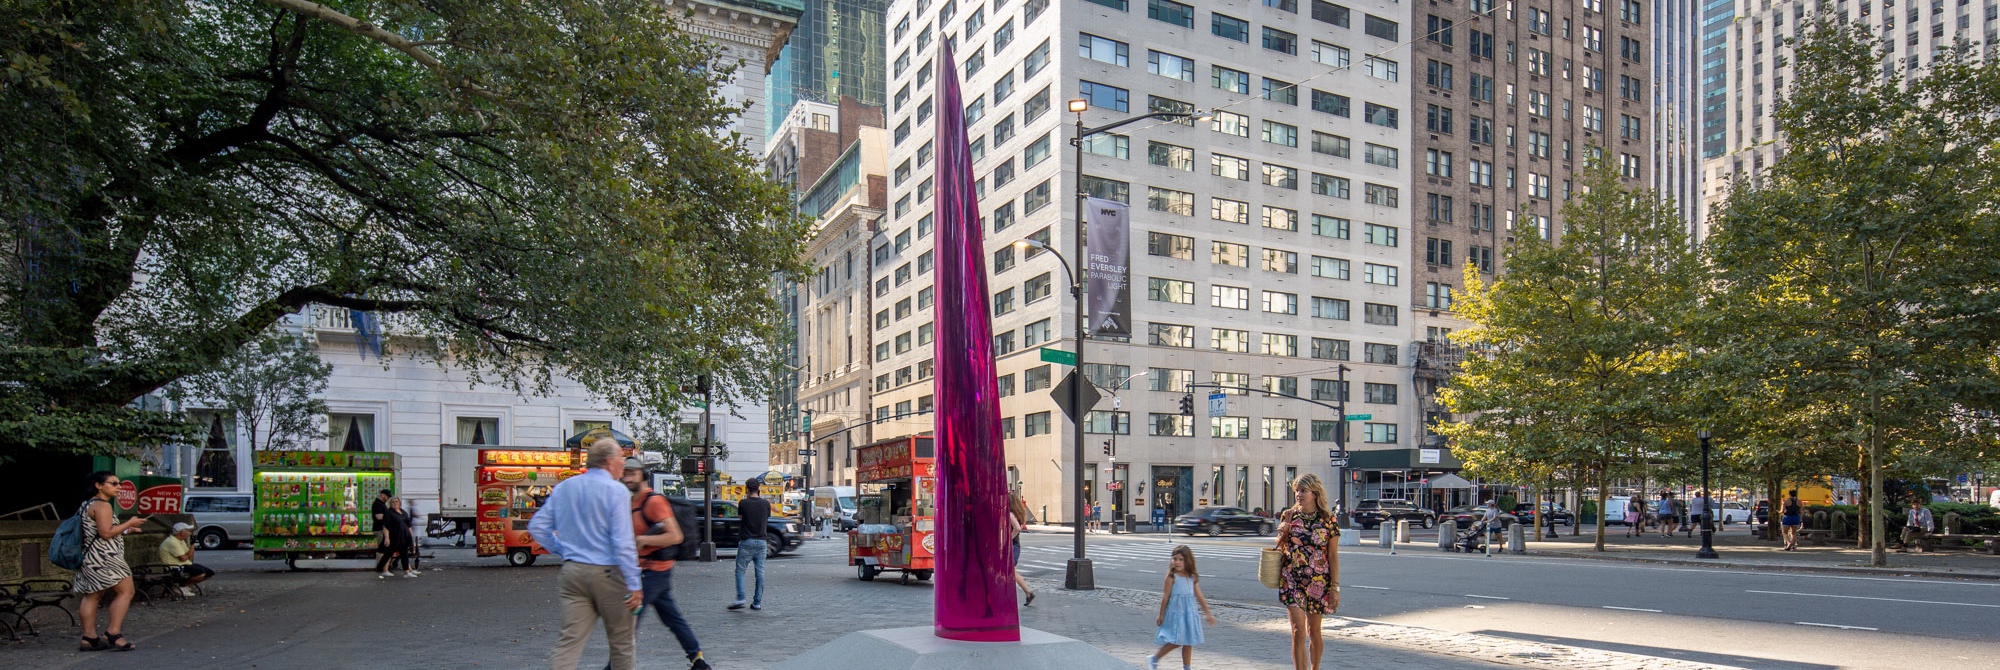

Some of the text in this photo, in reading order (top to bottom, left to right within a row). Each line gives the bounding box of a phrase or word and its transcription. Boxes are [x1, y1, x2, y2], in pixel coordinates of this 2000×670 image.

[1091, 254, 1108, 263] FRED
[1091, 263, 1127, 274] EVERSLEY
[1091, 272, 1126, 283] PARABOLIC
[1108, 282, 1127, 290] LIGHT
[117, 490, 135, 500] STRAND
[138, 496, 181, 511] STR
